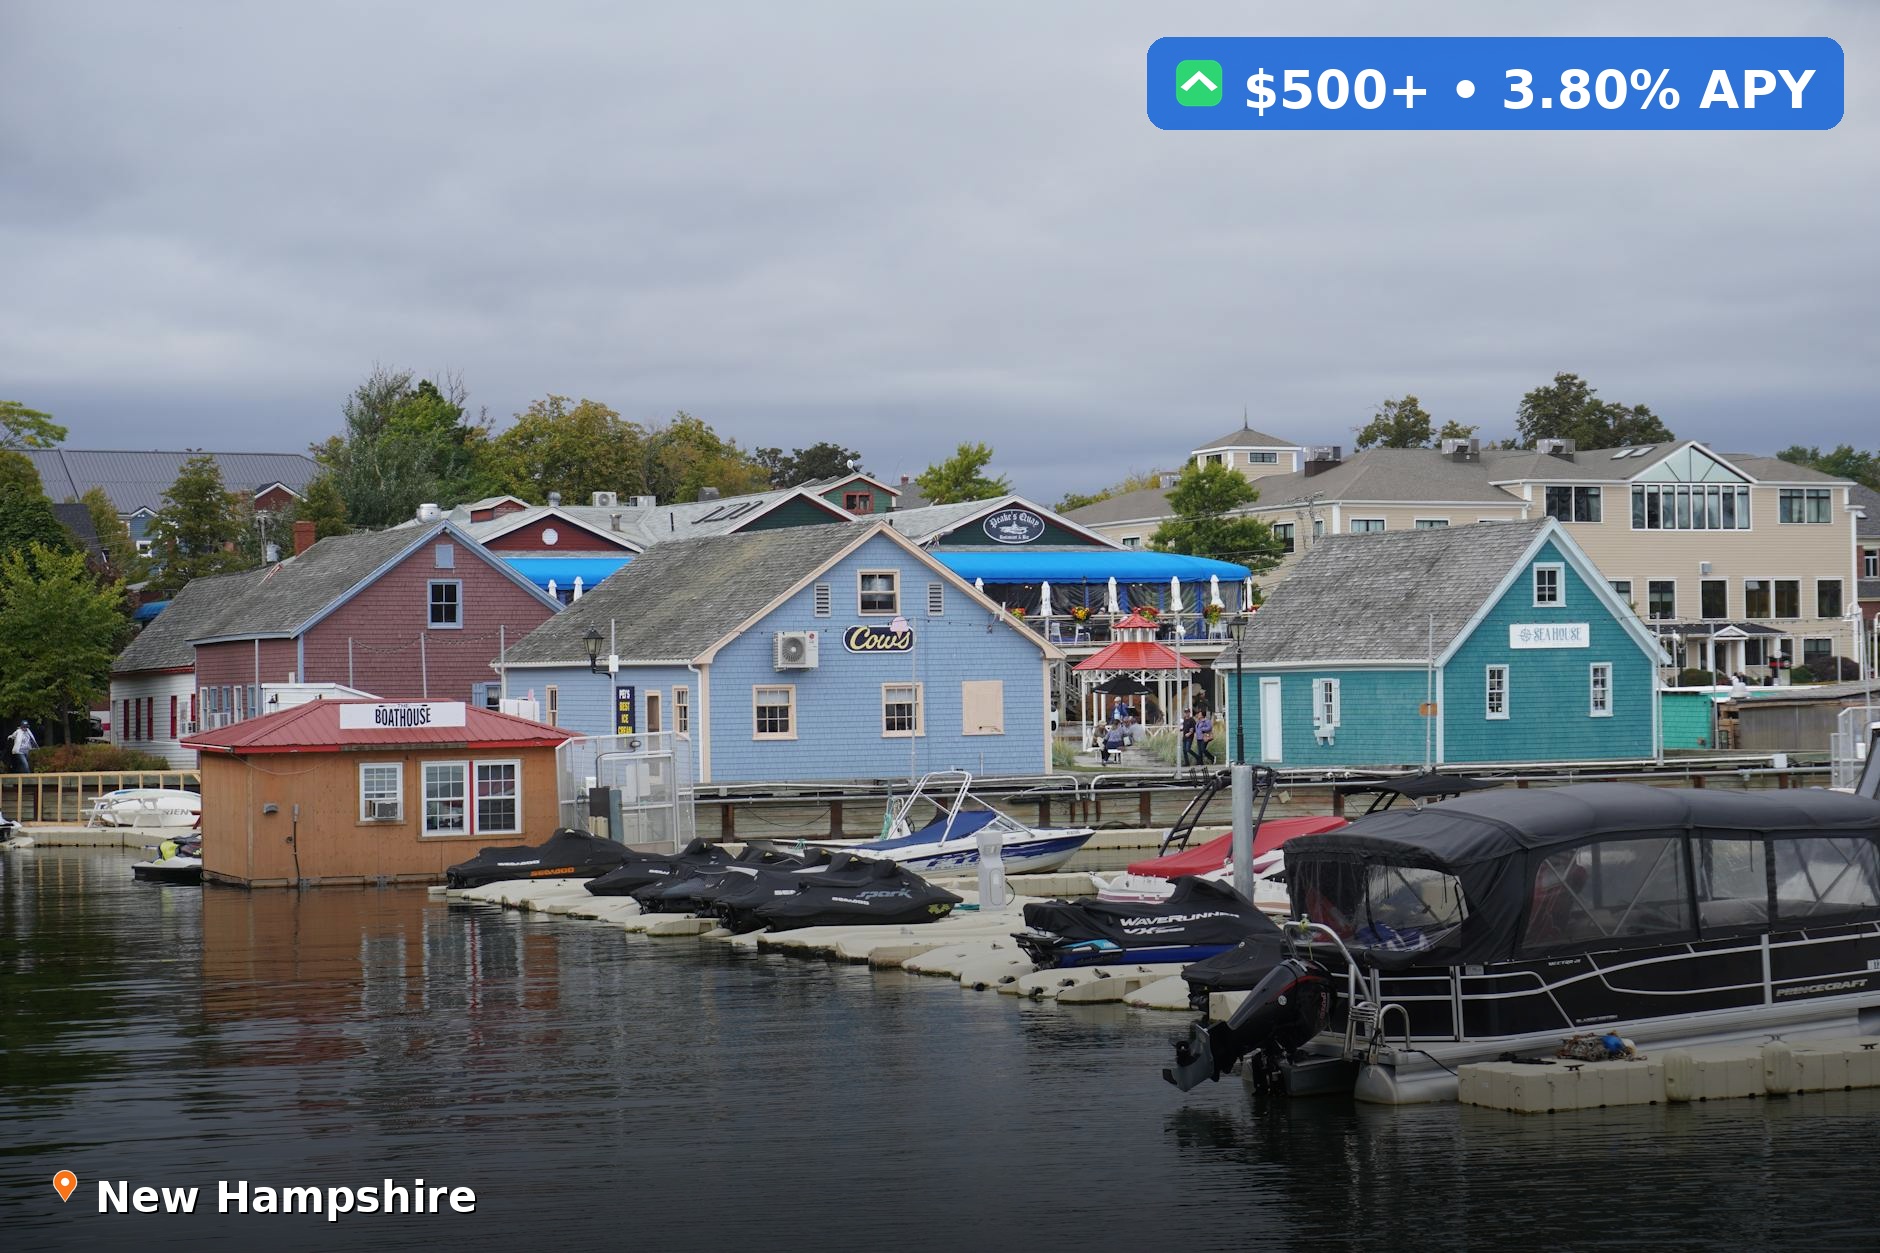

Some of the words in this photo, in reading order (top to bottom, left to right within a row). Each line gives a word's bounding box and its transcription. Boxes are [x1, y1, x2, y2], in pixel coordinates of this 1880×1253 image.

[1533, 627, 1551, 641] SEA
[1552, 626, 1582, 641] HOUSE
[375, 707, 431, 727] BOATHOUSE
